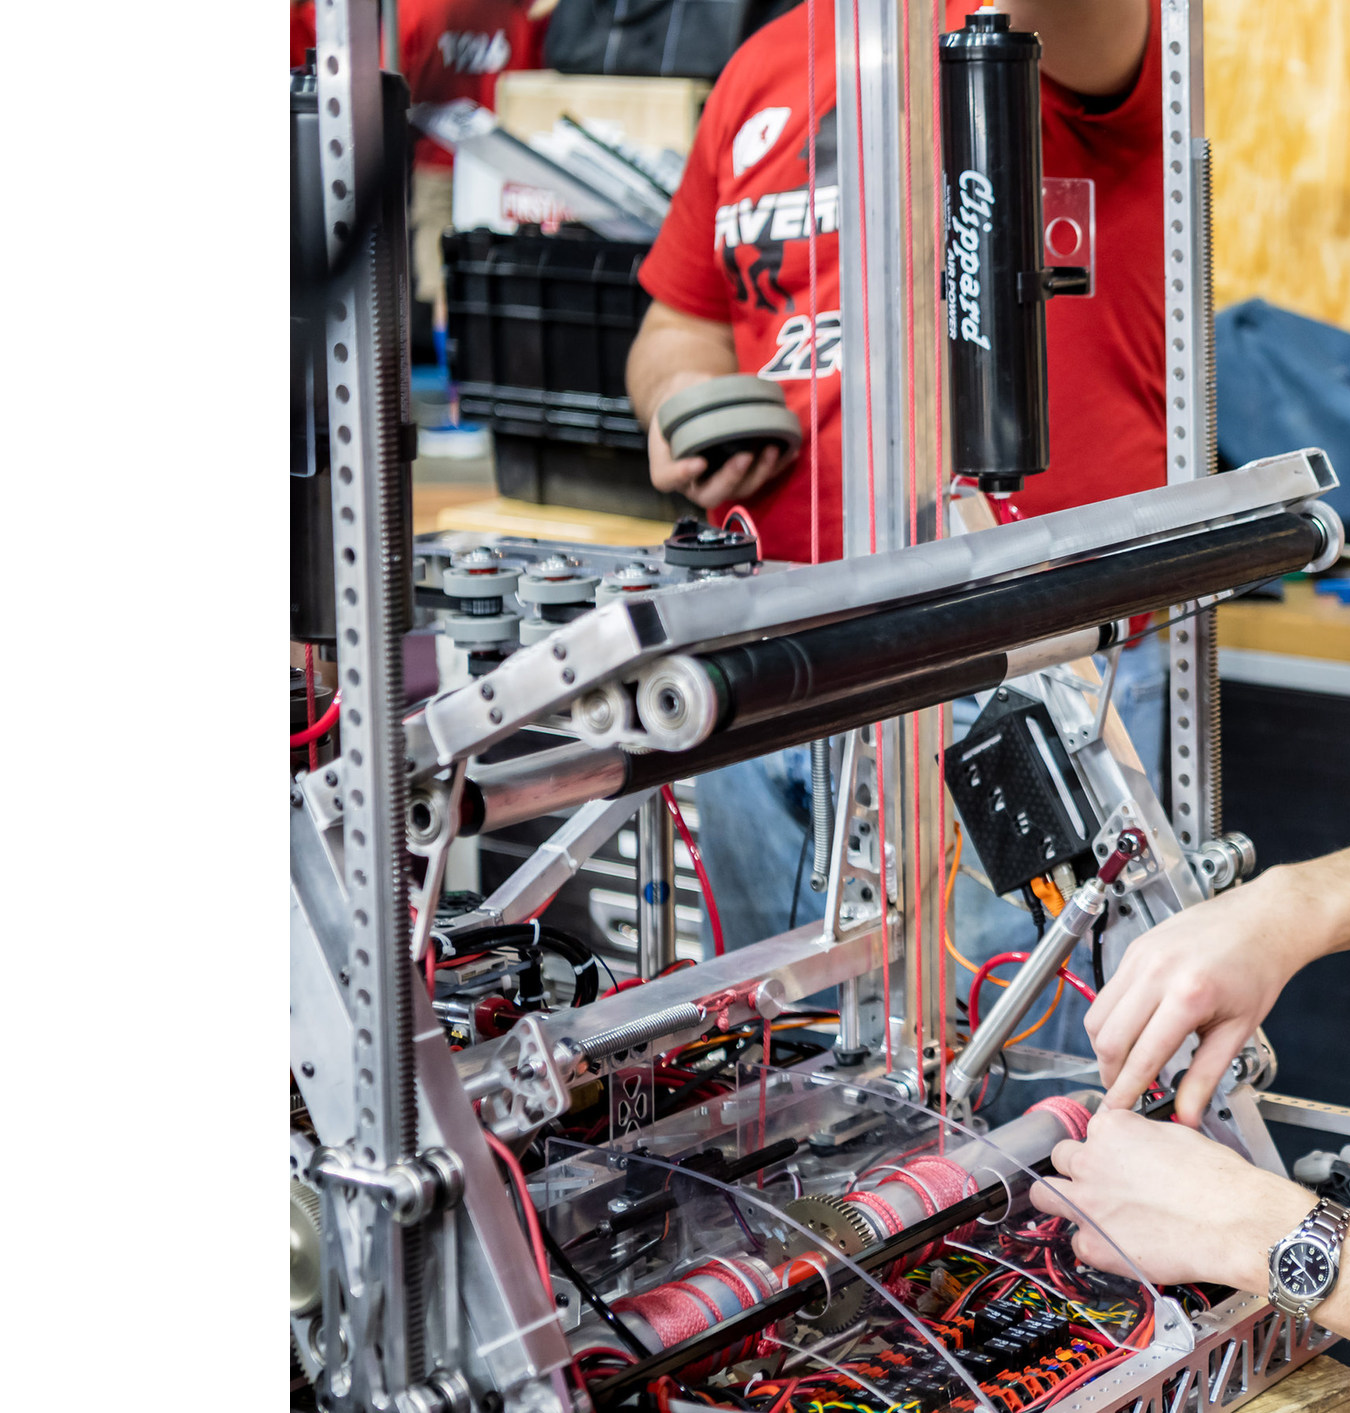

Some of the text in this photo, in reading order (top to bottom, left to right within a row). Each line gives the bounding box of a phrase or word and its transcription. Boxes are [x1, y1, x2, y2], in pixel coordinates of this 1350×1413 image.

[713, 185, 840, 251] AVER
[948, 248, 958, 340] AIR POWER
[952, 170, 995, 351] Clippard
[757, 310, 842, 381] 22
